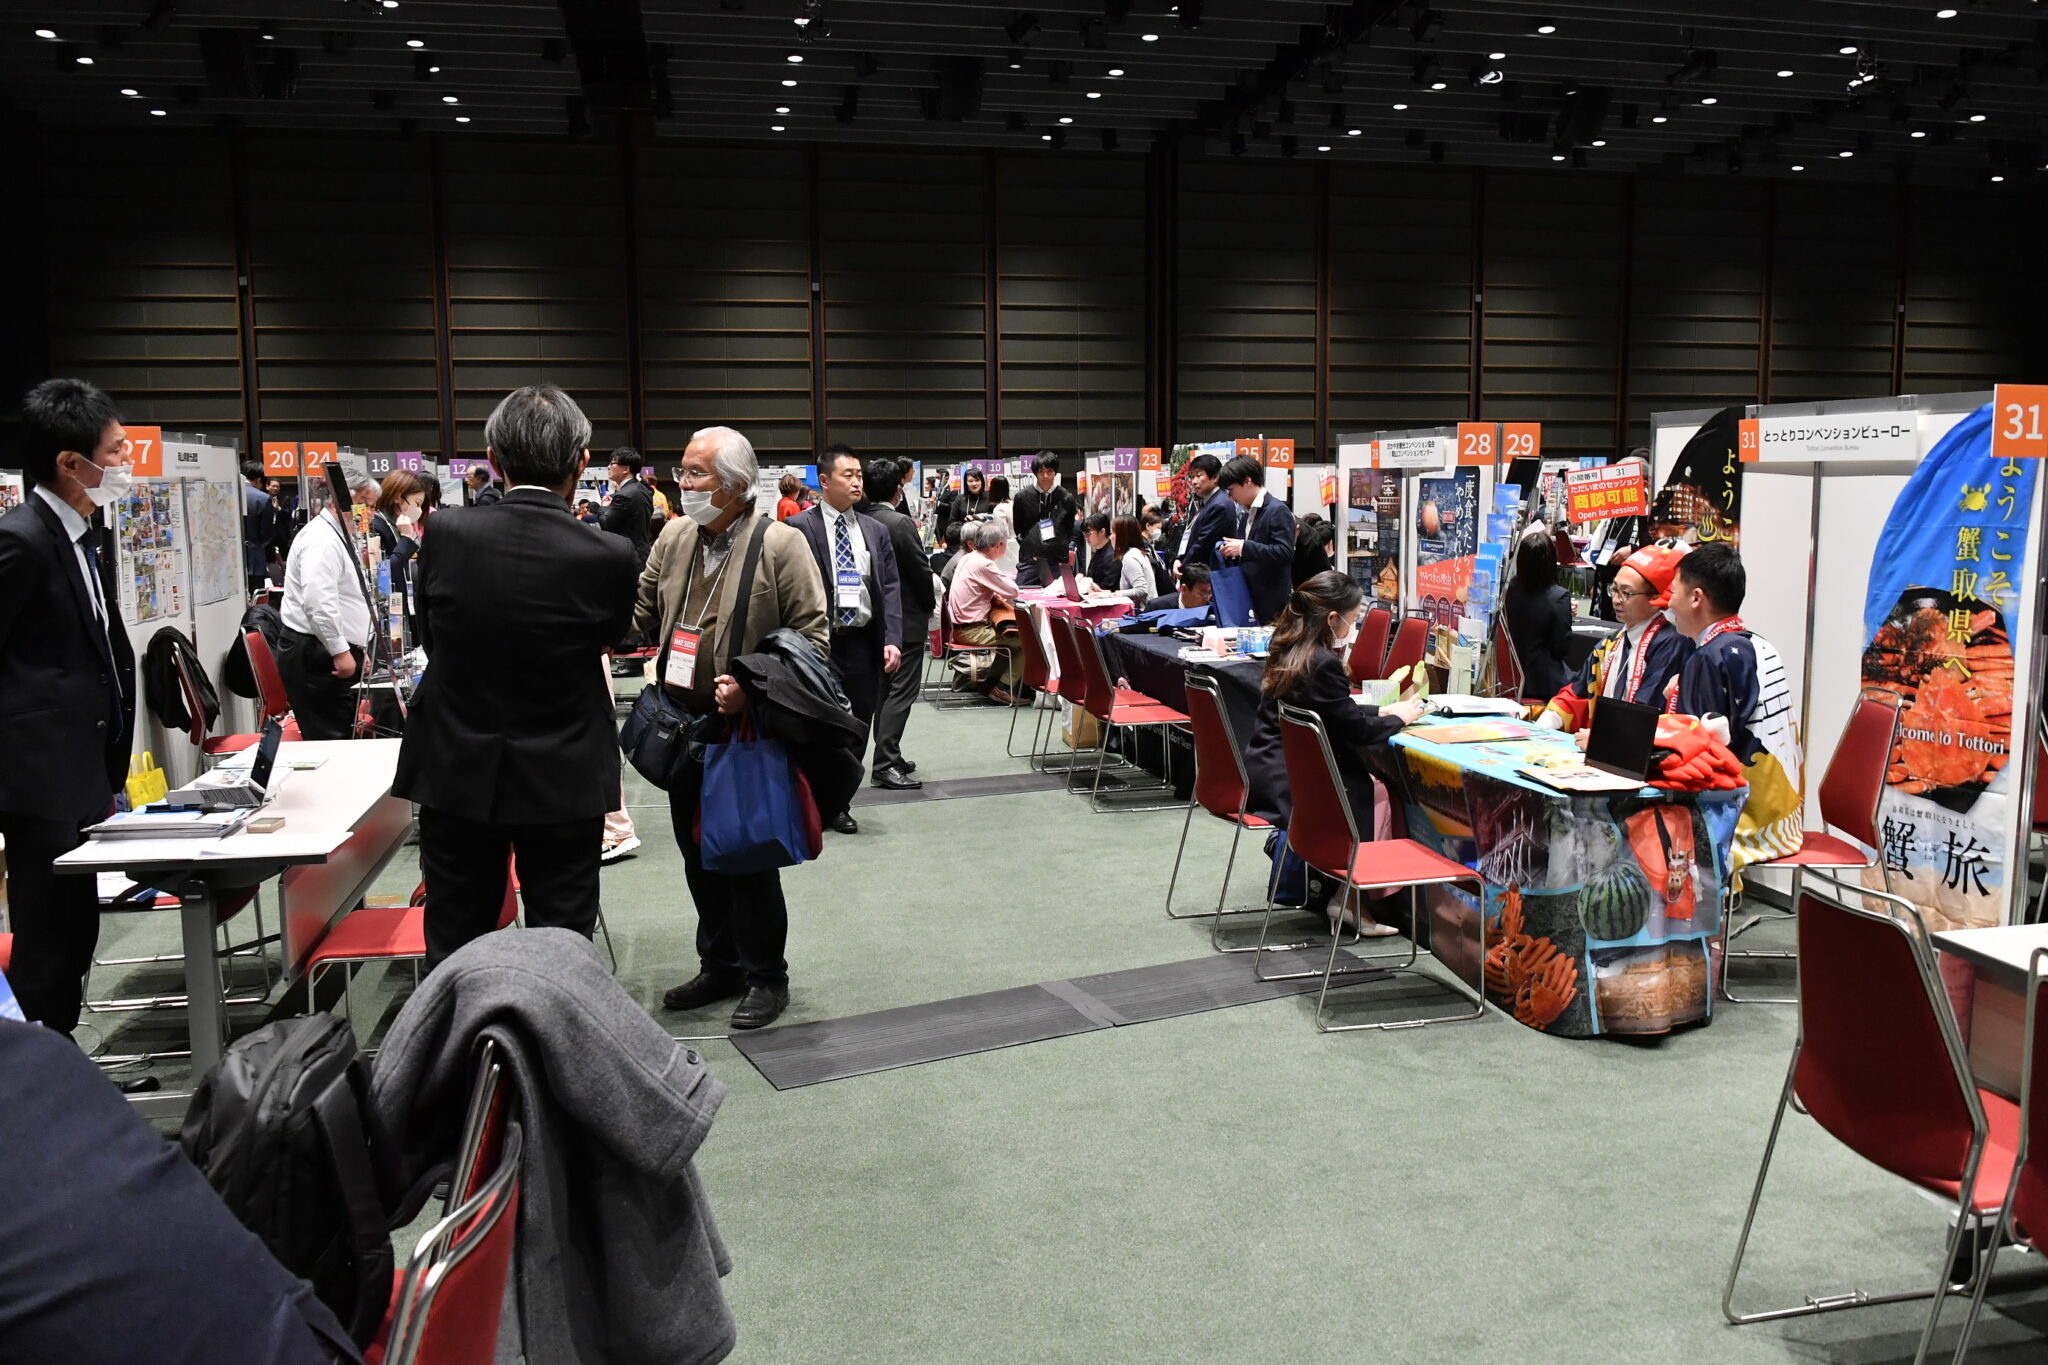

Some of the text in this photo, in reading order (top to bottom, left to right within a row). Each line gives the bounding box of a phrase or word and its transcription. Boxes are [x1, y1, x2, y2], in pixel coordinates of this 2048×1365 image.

[2003, 403, 2044, 440] 31
[1741, 432, 1756, 449] 31
[1763, 425, 1911, 443] とっとりコンベンションビューロー
[1463, 433, 1491, 456] 28
[1506, 433, 1534, 456] 29
[269, 450, 294, 469] 20
[307, 451, 332, 469] 24
[1118, 453, 1134, 466] 17
[1142, 453, 1158, 467] 23
[1270, 446, 1290, 463] 26
[371, 458, 390, 473] 18
[400, 457, 418, 472] 16
[452, 463, 467, 475] 12
[990, 463, 1001, 472] 10
[1615, 467, 1626, 477] 31
[1571, 477, 1640, 494] ただいまのセッション
[1573, 487, 1639, 510] 商談可能
[1577, 504, 1639, 521] Open for session
[1943, 526, 1982, 679] 蟹取県へ
[1938, 728, 1952, 746] to
[1956, 731, 2005, 755] Tottori
